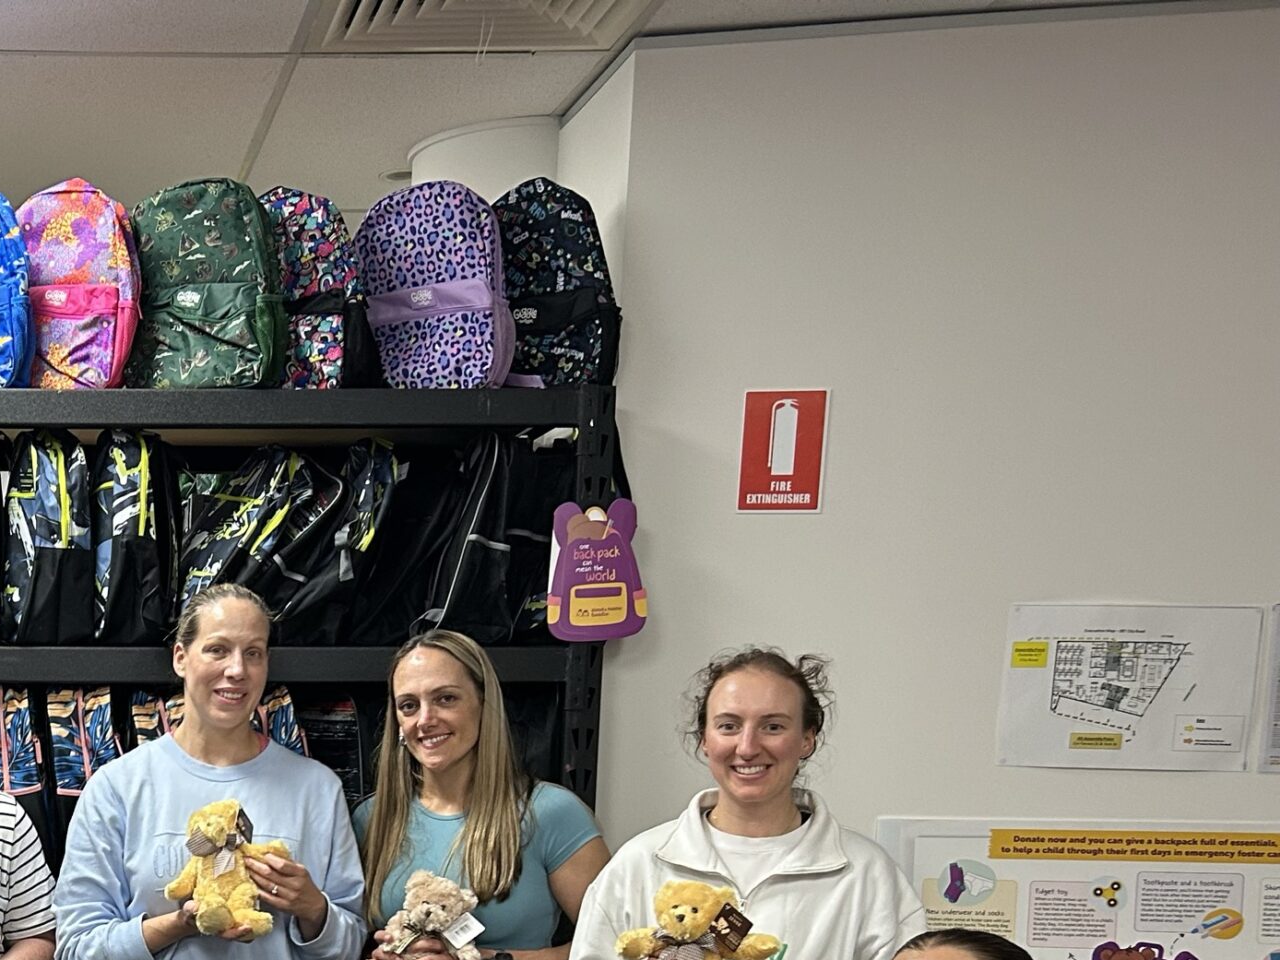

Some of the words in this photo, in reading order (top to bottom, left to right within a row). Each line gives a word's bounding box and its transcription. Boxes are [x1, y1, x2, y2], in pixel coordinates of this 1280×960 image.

[770, 481, 792, 492] FIRE
[746, 493, 811, 505] EXTINGUISHER
[573, 549, 596, 560] back
[597, 545, 620, 562] pack
[585, 568, 616, 582] world
[1013, 835, 1045, 843] Donate
[1069, 836, 1087, 844] and
[1125, 837, 1145, 846] give
[1154, 838, 1198, 846] backpack
[1200, 838, 1216, 846] full
[1230, 839, 1278, 847] essentials,
[1012, 846, 1033, 855] help
[1042, 846, 1065, 854] child
[1067, 847, 1104, 856] through
[1151, 848, 1171, 857] days
[1184, 850, 1235, 859] emergency
[1237, 850, 1266, 858] foster
[1057, 888, 1068, 896] toy
